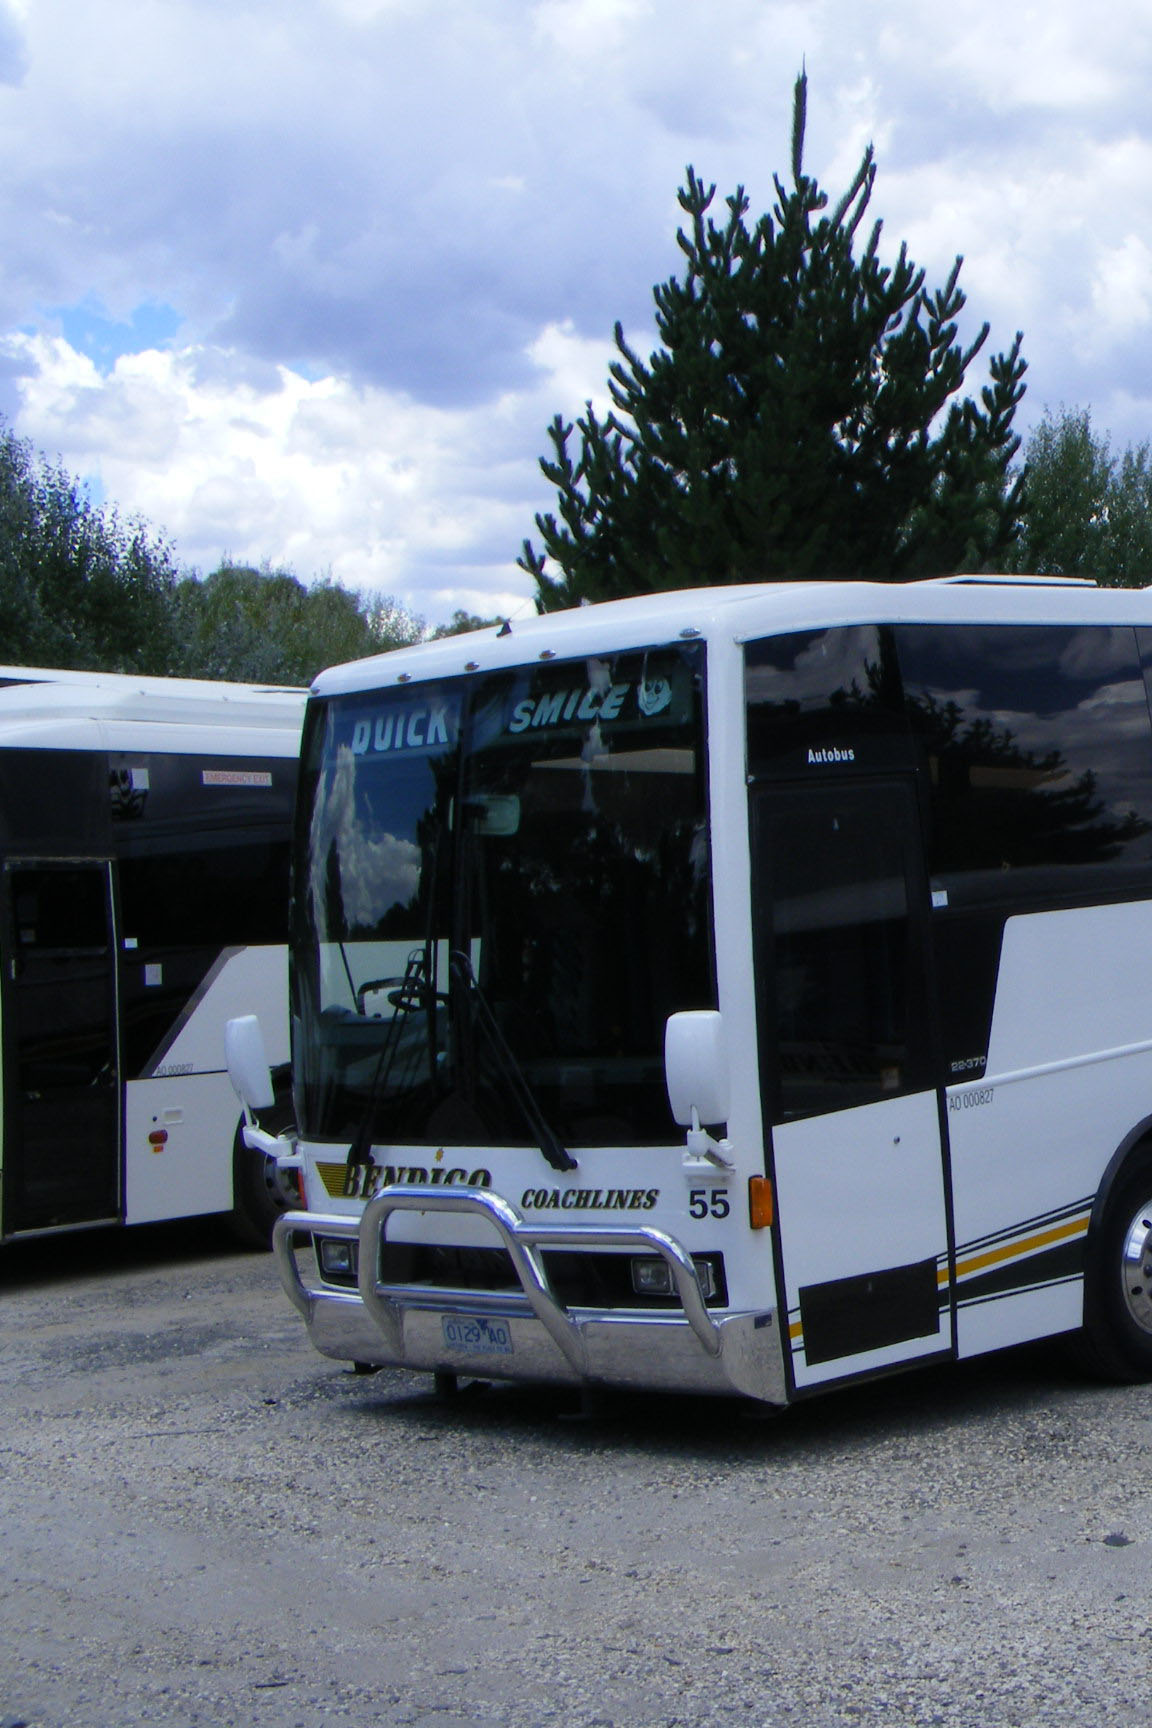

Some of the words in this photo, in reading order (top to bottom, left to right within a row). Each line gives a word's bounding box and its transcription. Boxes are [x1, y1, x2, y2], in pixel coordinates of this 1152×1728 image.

[352, 706, 448, 755] QUICK
[509, 684, 630, 733] SMILE
[808, 747, 855, 763] Autobus
[963, 1088, 994, 1109] 000827
[521, 1188, 660, 1211] COACHLINES
[689, 1189, 731, 1219] 55
[446, 1324, 481, 1343] 0129
